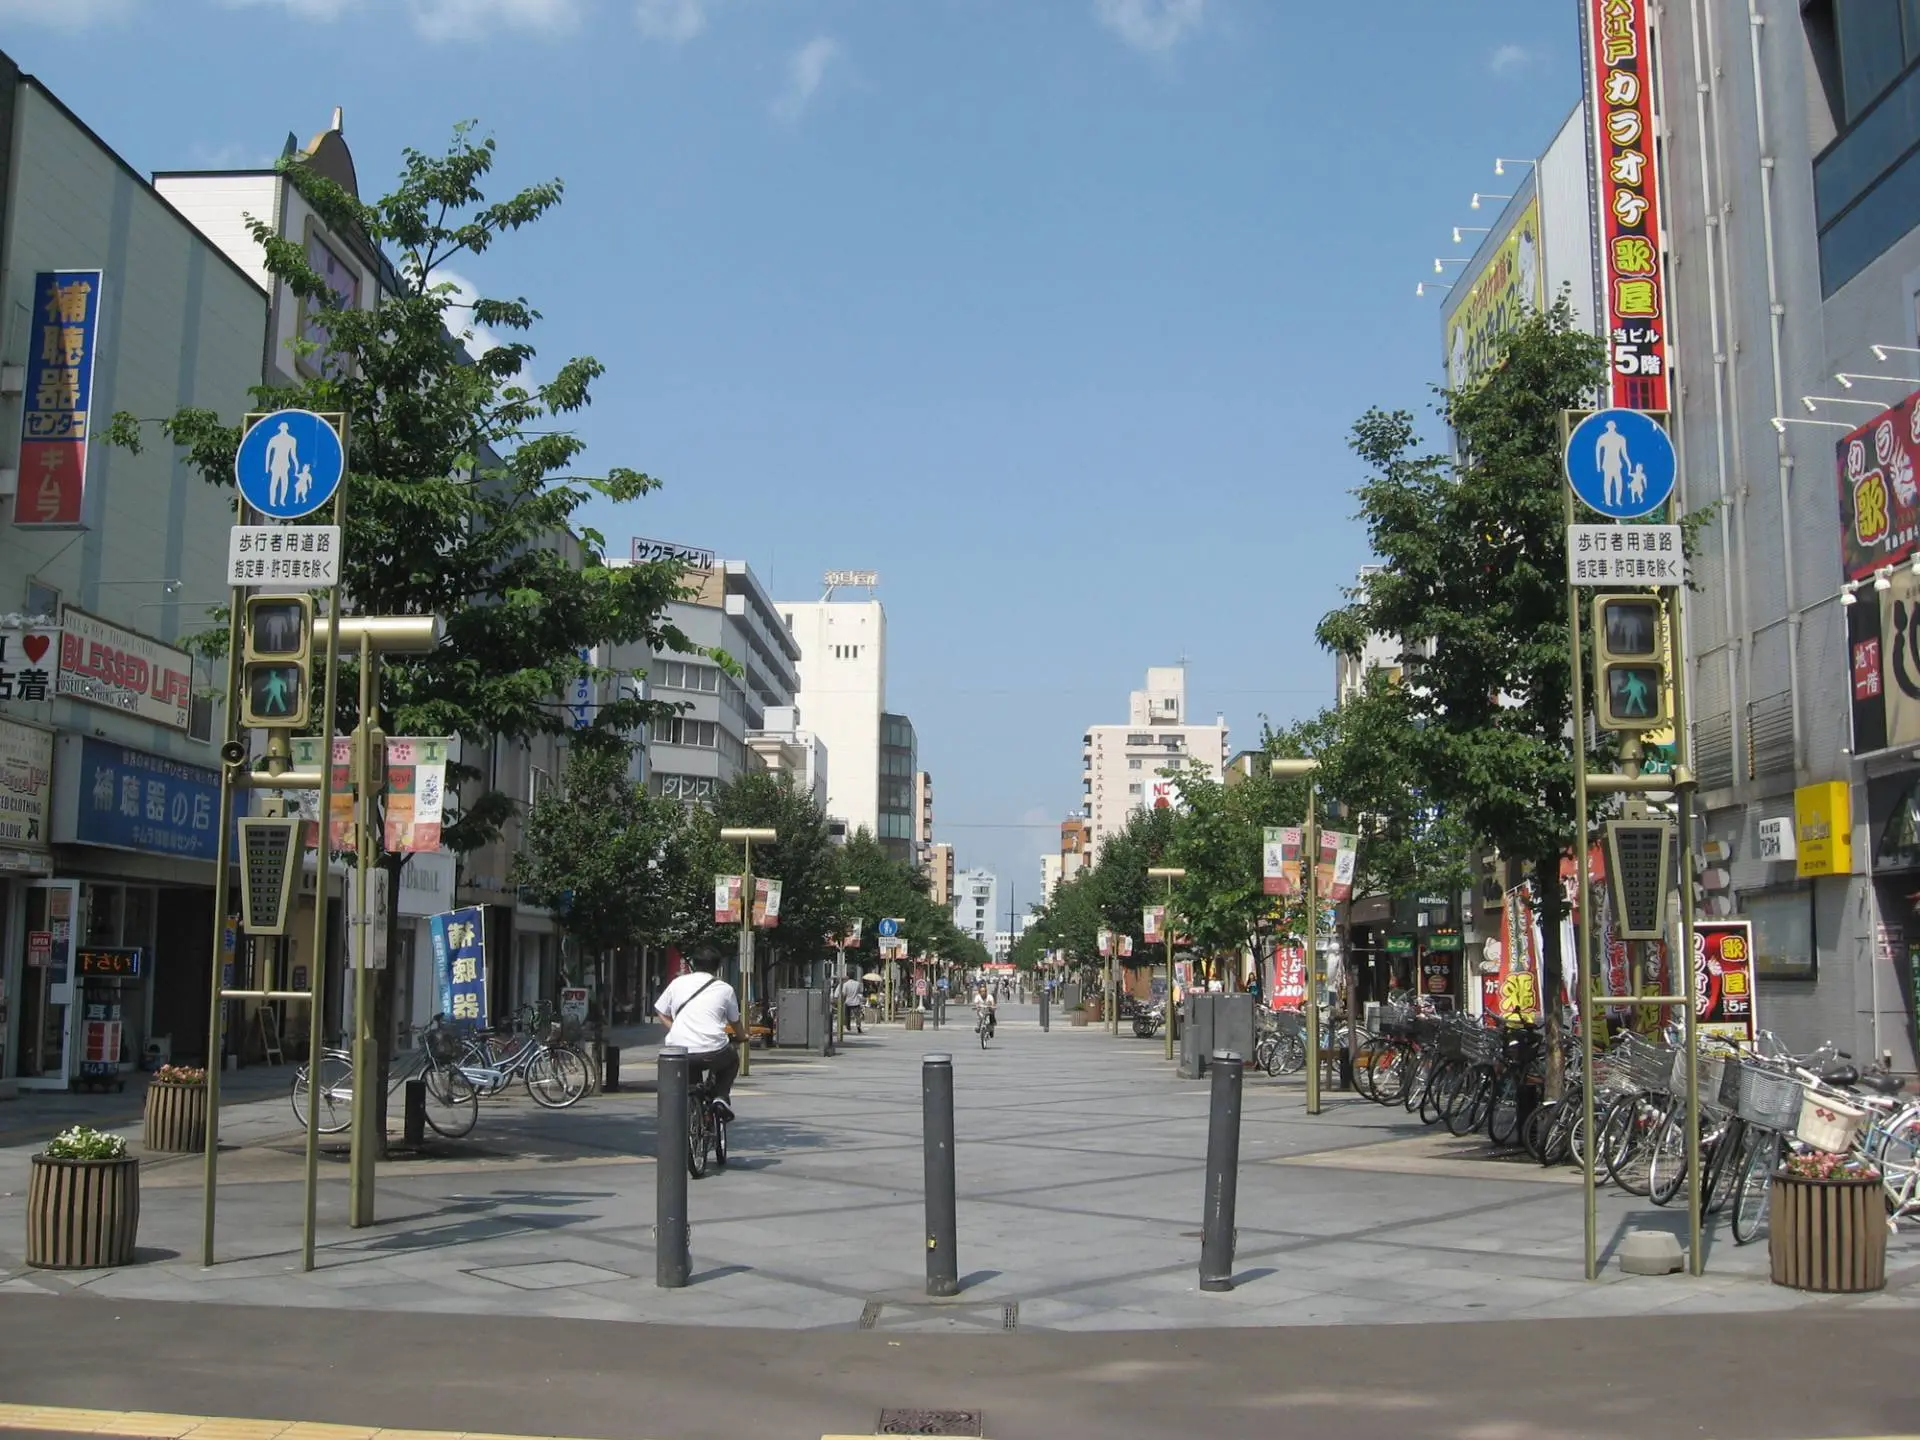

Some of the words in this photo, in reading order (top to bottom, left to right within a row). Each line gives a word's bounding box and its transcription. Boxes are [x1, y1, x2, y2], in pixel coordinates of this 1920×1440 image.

[36, 281, 90, 411] 補聴器
[1613, 329, 1659, 344] 当ビル
[1615, 346, 1661, 375] 5階
[27, 415, 84, 438] センター
[37, 448, 65, 521] キムラ
[239, 533, 331, 552] 歩行者用道路
[1578, 532, 1673, 551] 歩行者用道路
[637, 542, 713, 570] サクライビル
[235, 559, 331, 579] 指定車・許可車を除く
[1576, 559, 1677, 579] 指定車・許可車を除く
[61, 632, 149, 696] BLESSED
[152, 664, 190, 710] LIFE
[93, 766, 211, 830] 補聴器の店
[32, 937, 49, 946] OPEN
[78, 952, 131, 971] 下さい
[1723, 938, 1744, 993] 歌屋
[1729, 1001, 1748, 1012] 5F
